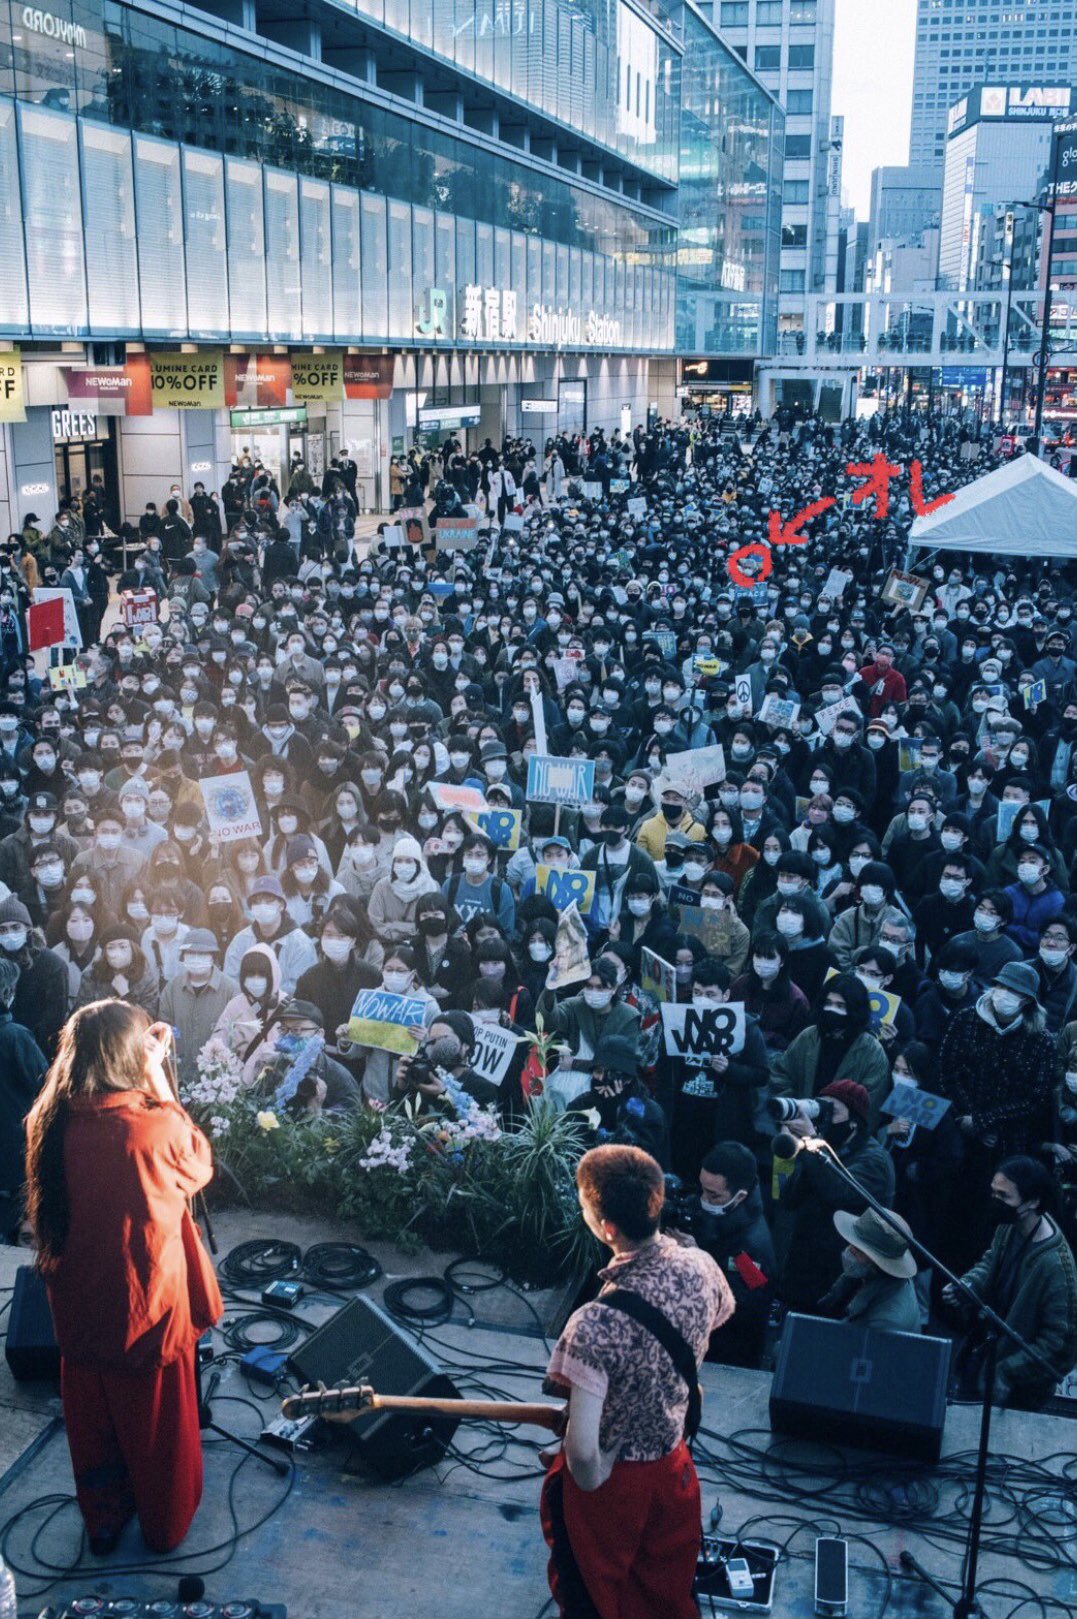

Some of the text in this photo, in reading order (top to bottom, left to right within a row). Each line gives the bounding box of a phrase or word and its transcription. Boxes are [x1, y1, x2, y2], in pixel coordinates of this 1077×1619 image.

[1009, 87, 1071, 106] LABI
[1008, 107, 1046, 116] SHINJUKU
[418, 288, 446, 334] JR
[531, 303, 621, 349] Shinjuku Station
[191, 364, 217, 373] CARD
[314, 363, 338, 371] CARD
[0, 380, 15, 399] F
[820, 698, 851, 720] PEACE
[232, 821, 260, 834] WAR
[685, 1008, 736, 1036] NO
[484, 1031, 508, 1049] PUTIN
[671, 1029, 735, 1056] WAR
